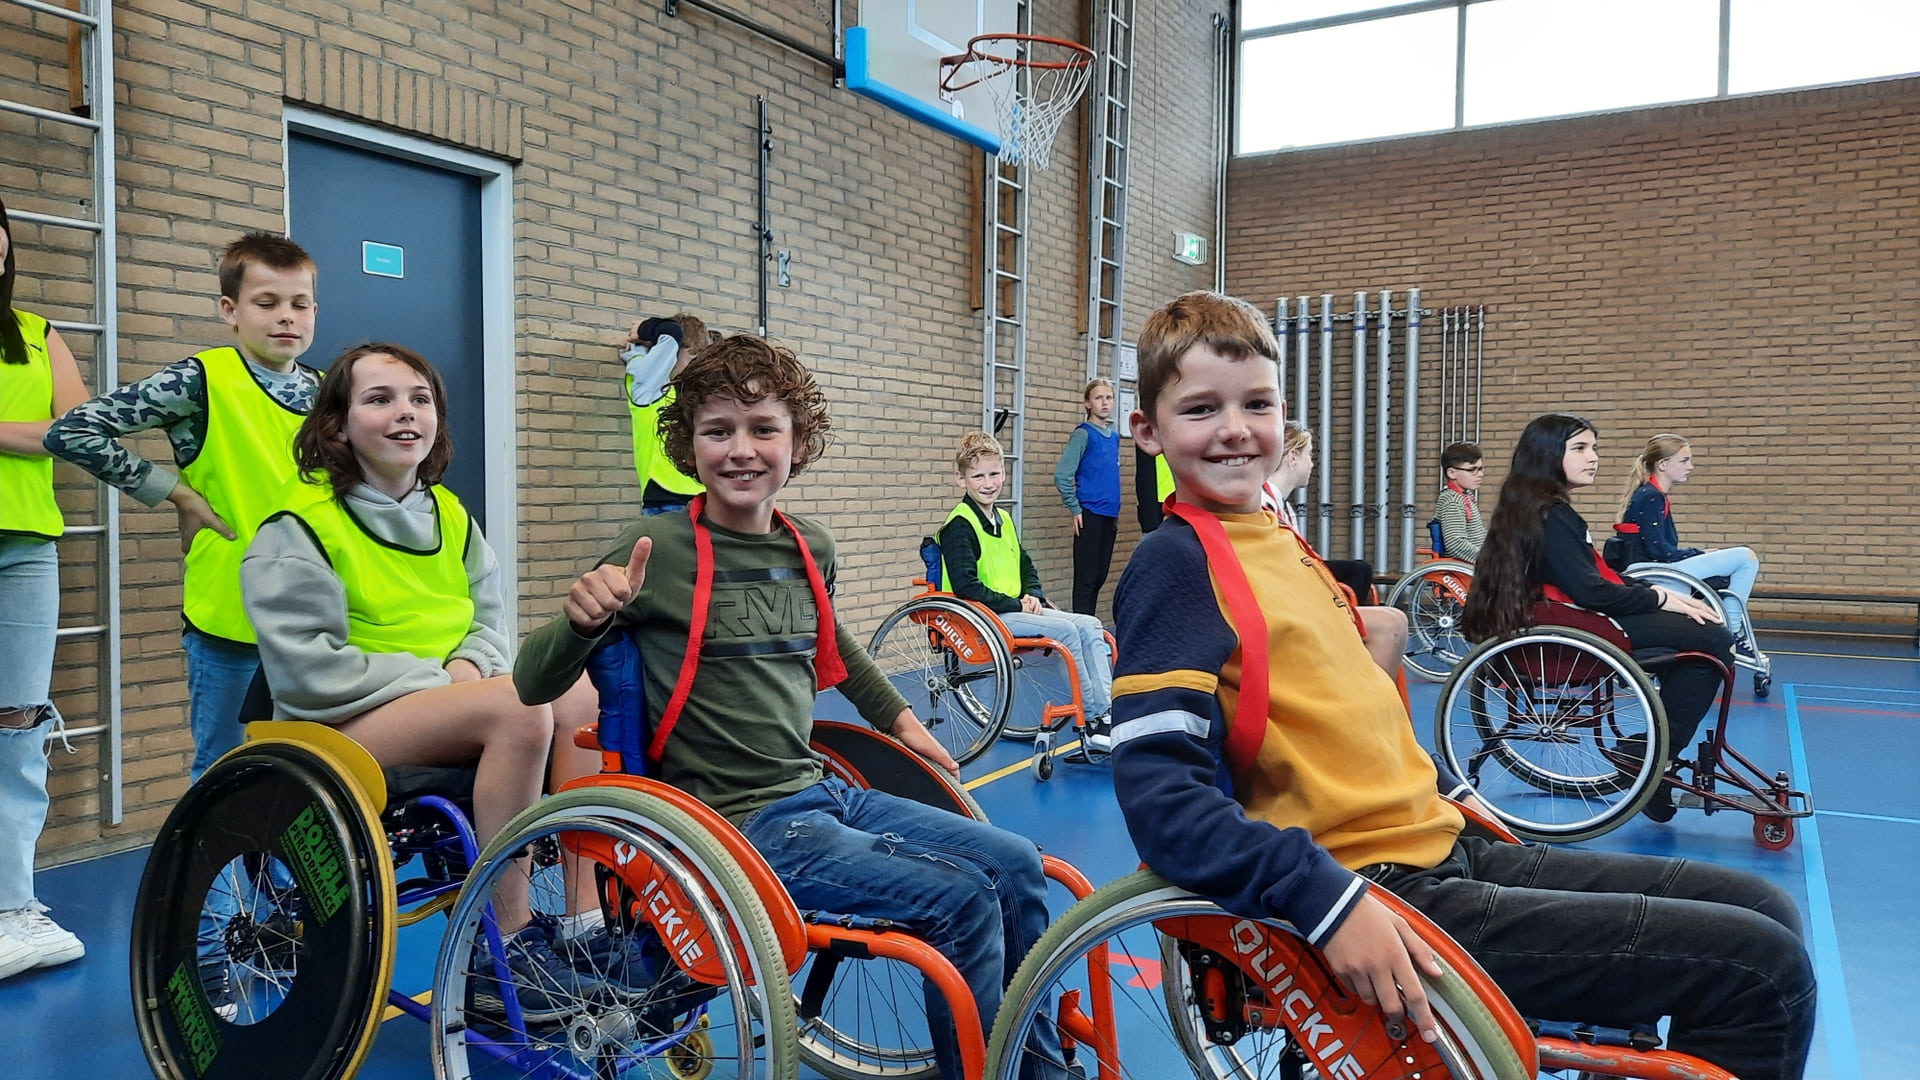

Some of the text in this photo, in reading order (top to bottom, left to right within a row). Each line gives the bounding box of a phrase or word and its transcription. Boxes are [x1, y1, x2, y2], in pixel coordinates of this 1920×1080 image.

[1442, 575, 1468, 602] QUICK
[935, 614, 974, 659] QUICKIE
[289, 823, 337, 914] PERFORMANCE
[297, 805, 351, 904] DOUBLE
[1229, 919, 1365, 1080] QUICKIE
